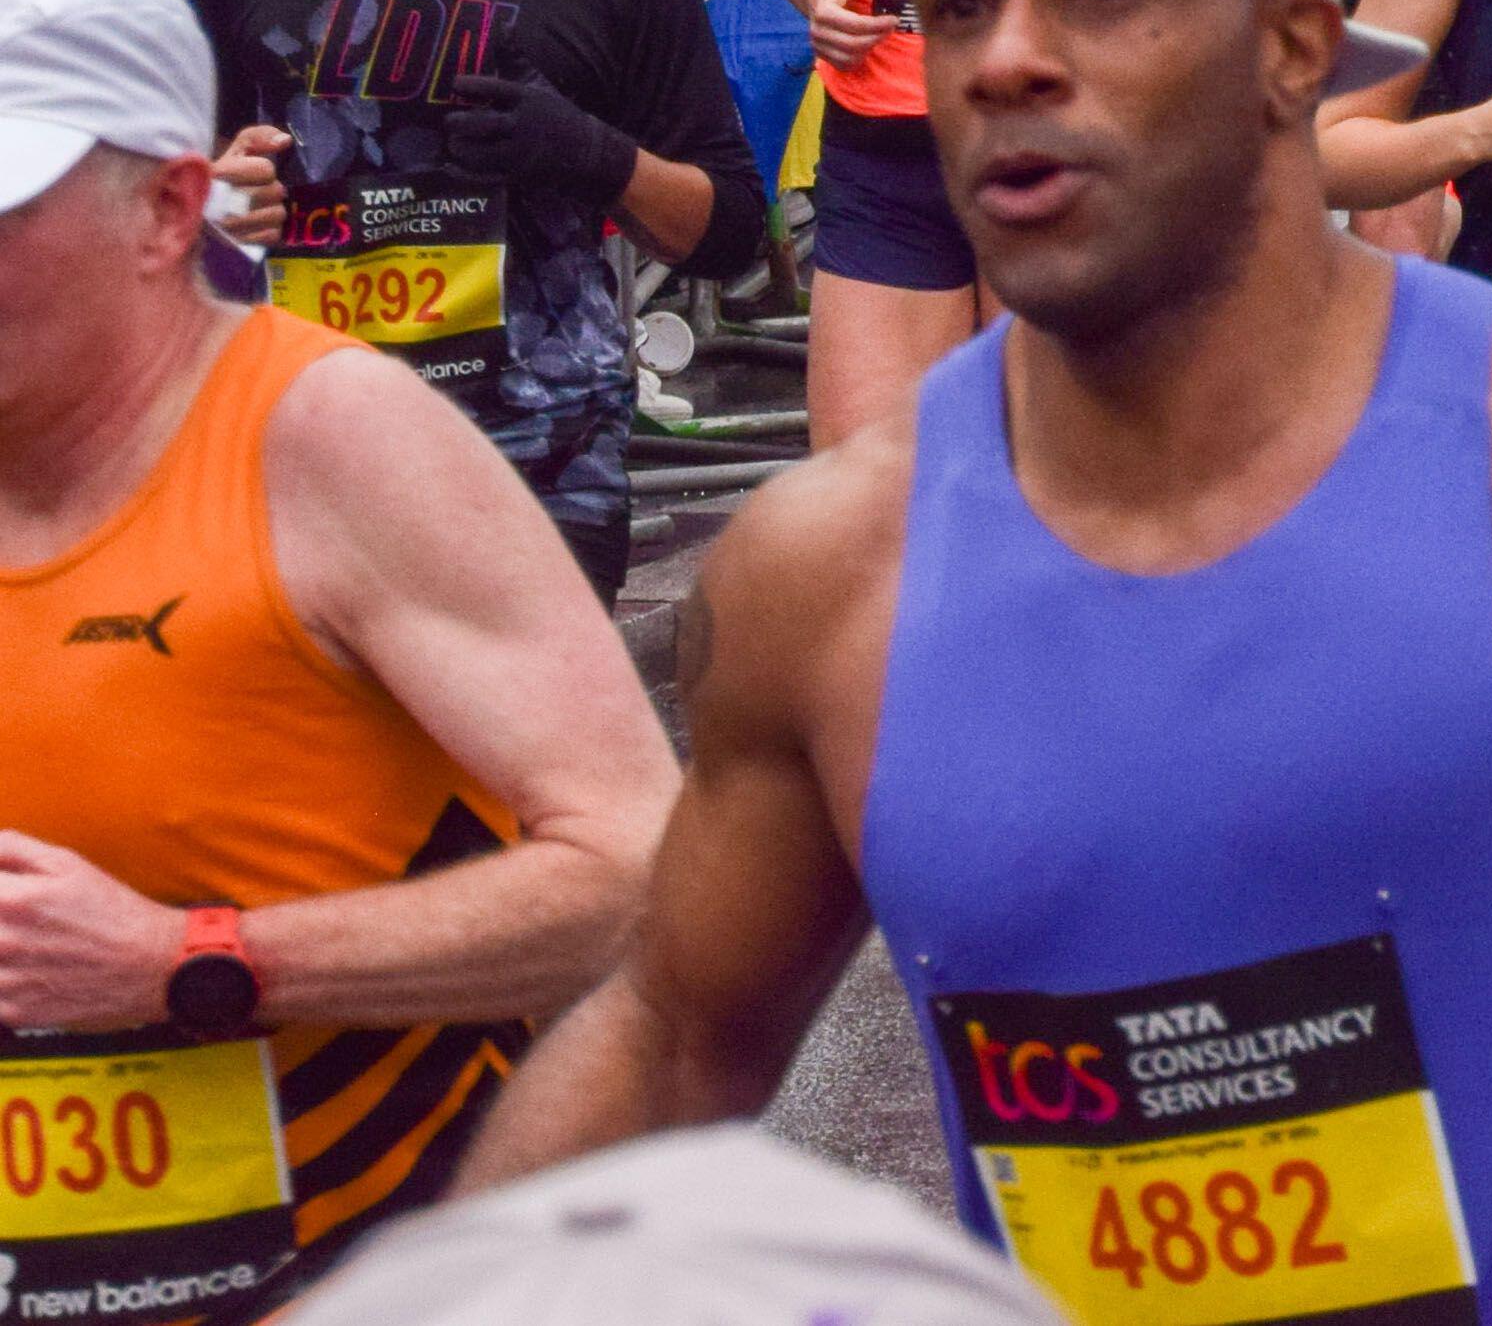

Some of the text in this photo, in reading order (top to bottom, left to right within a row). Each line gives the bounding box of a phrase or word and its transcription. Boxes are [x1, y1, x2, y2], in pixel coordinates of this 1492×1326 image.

[362, 187, 415, 206] TATA
[362, 197, 489, 225] CONSULTANCY
[362, 217, 442, 244] SERVICES
[319, 267, 446, 334] 6292
[1116, 1001, 1227, 1045] TATA
[1128, 1004, 1377, 1085] CONSULTANCY
[966, 1020, 1122, 1125] tcs
[1138, 1065, 1297, 1121] SERVICES
[1088, 1159, 1347, 1292] 4882
[20, 1262, 255, 1319] new balance
